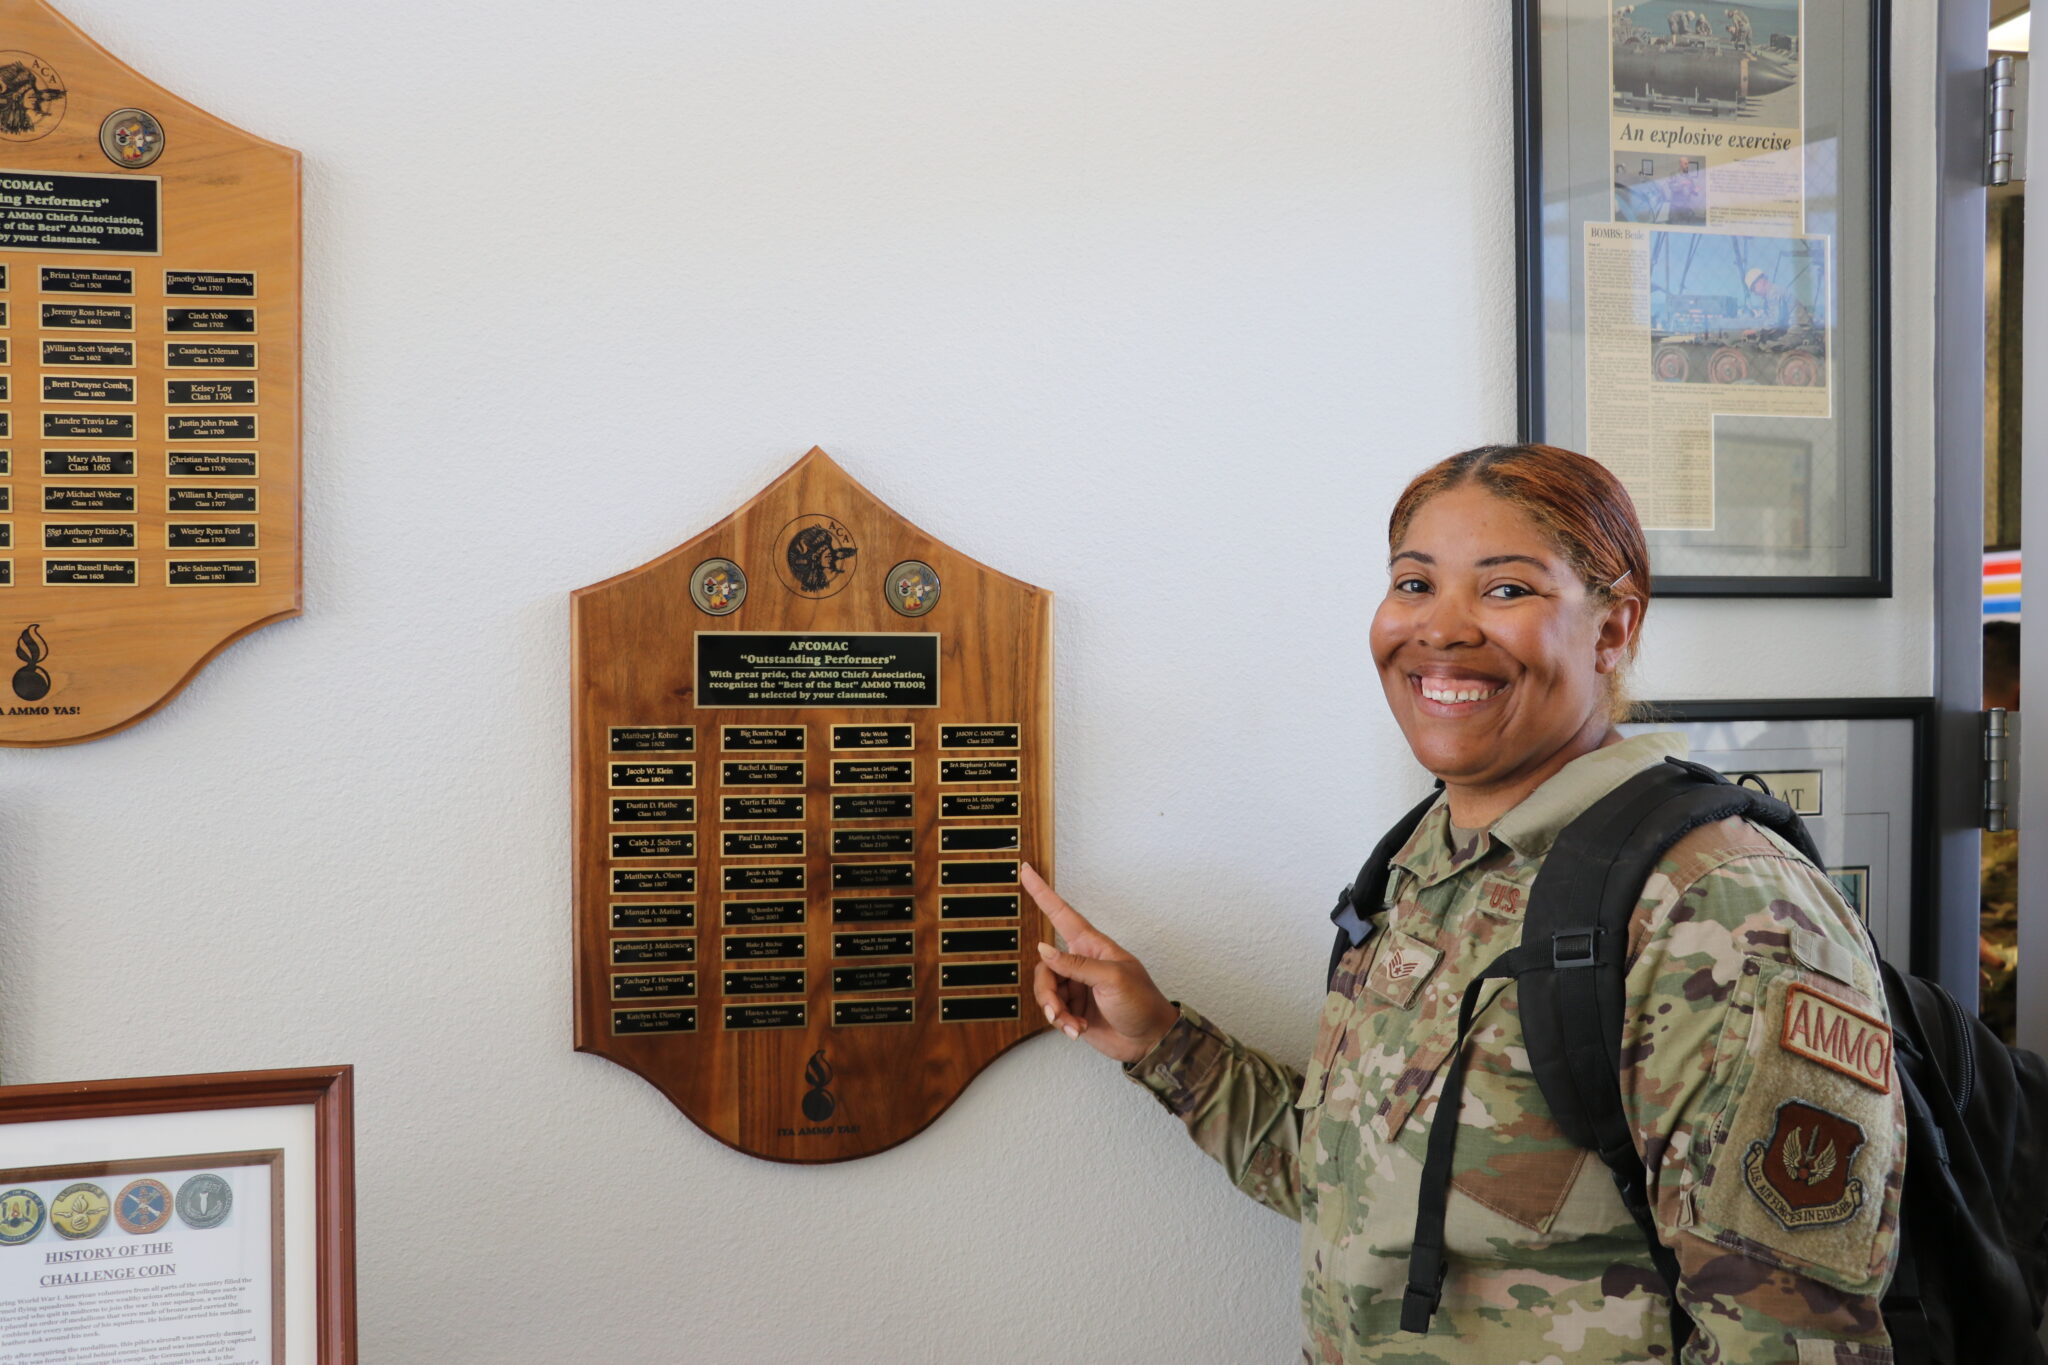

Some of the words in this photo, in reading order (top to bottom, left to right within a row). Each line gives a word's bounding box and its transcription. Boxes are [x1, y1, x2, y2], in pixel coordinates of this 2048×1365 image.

[32, 59, 56, 84] ACA
[1621, 123, 1644, 141] An
[1650, 126, 1723, 148] explosive
[1728, 133, 1792, 151] exercise
[0, 180, 53, 191] COMAC
[25, 195, 109, 207] Performers"
[8, 211, 43, 220] AMMO
[46, 213, 78, 222] Chiefs
[81, 215, 143, 225] Association,
[4, 222, 14, 230] of
[18, 223, 35, 231] the
[38, 224, 66, 232] Best"
[69, 225, 104, 234] AMMO
[107, 226, 144, 236] TROOP,
[1591, 228, 1623, 240] BOMBS:
[13, 234, 41, 243] your
[42, 234, 100, 244] classmates.
[72, 272, 90, 280] Lynn
[51, 308, 77, 317] Jeremy
[71, 381, 101, 389] Dwayne
[191, 385, 215, 393] Kelsey
[217, 385, 231, 393] Loy
[200, 420, 217, 428] John
[53, 491, 64, 499] Jay
[64, 528, 93, 536] Anthony
[828, 521, 850, 543] ACA
[789, 642, 848, 650] AFCOMAC
[741, 654, 821, 665] "Outstanding
[824, 655, 896, 665] Performers"
[735, 671, 759, 680] great
[761, 671, 789, 680] pride,
[842, 671, 869, 679] Chiefs
[871, 671, 925, 680] Association,
[709, 681, 758, 689] recognizes
[893, 681, 926, 690] TROOP,
[761, 691, 797, 699] selected
[800, 691, 810, 700] by
[813, 692, 835, 700] your
[837, 691, 888, 699] classmates.
[8, 707, 49, 715] AMMO
[53, 707, 80, 715] YAS!
[626, 768, 645, 776] Jacob
[1490, 884, 1521, 914] U.S.
[1789, 999, 1888, 1080] AMMO
[1757, 1185, 1771, 1199] AIR
[1771, 1197, 1801, 1223] FORCES
[1805, 1211, 1815, 1222] IN
[1816, 1201, 1852, 1221] EUROPE
[46, 1247, 116, 1263] HISTORY
[118, 1244, 140, 1256] OF
[142, 1242, 174, 1254] THE
[40, 1267, 135, 1286] CHALLENGE
[138, 1264, 176, 1278] COIN
